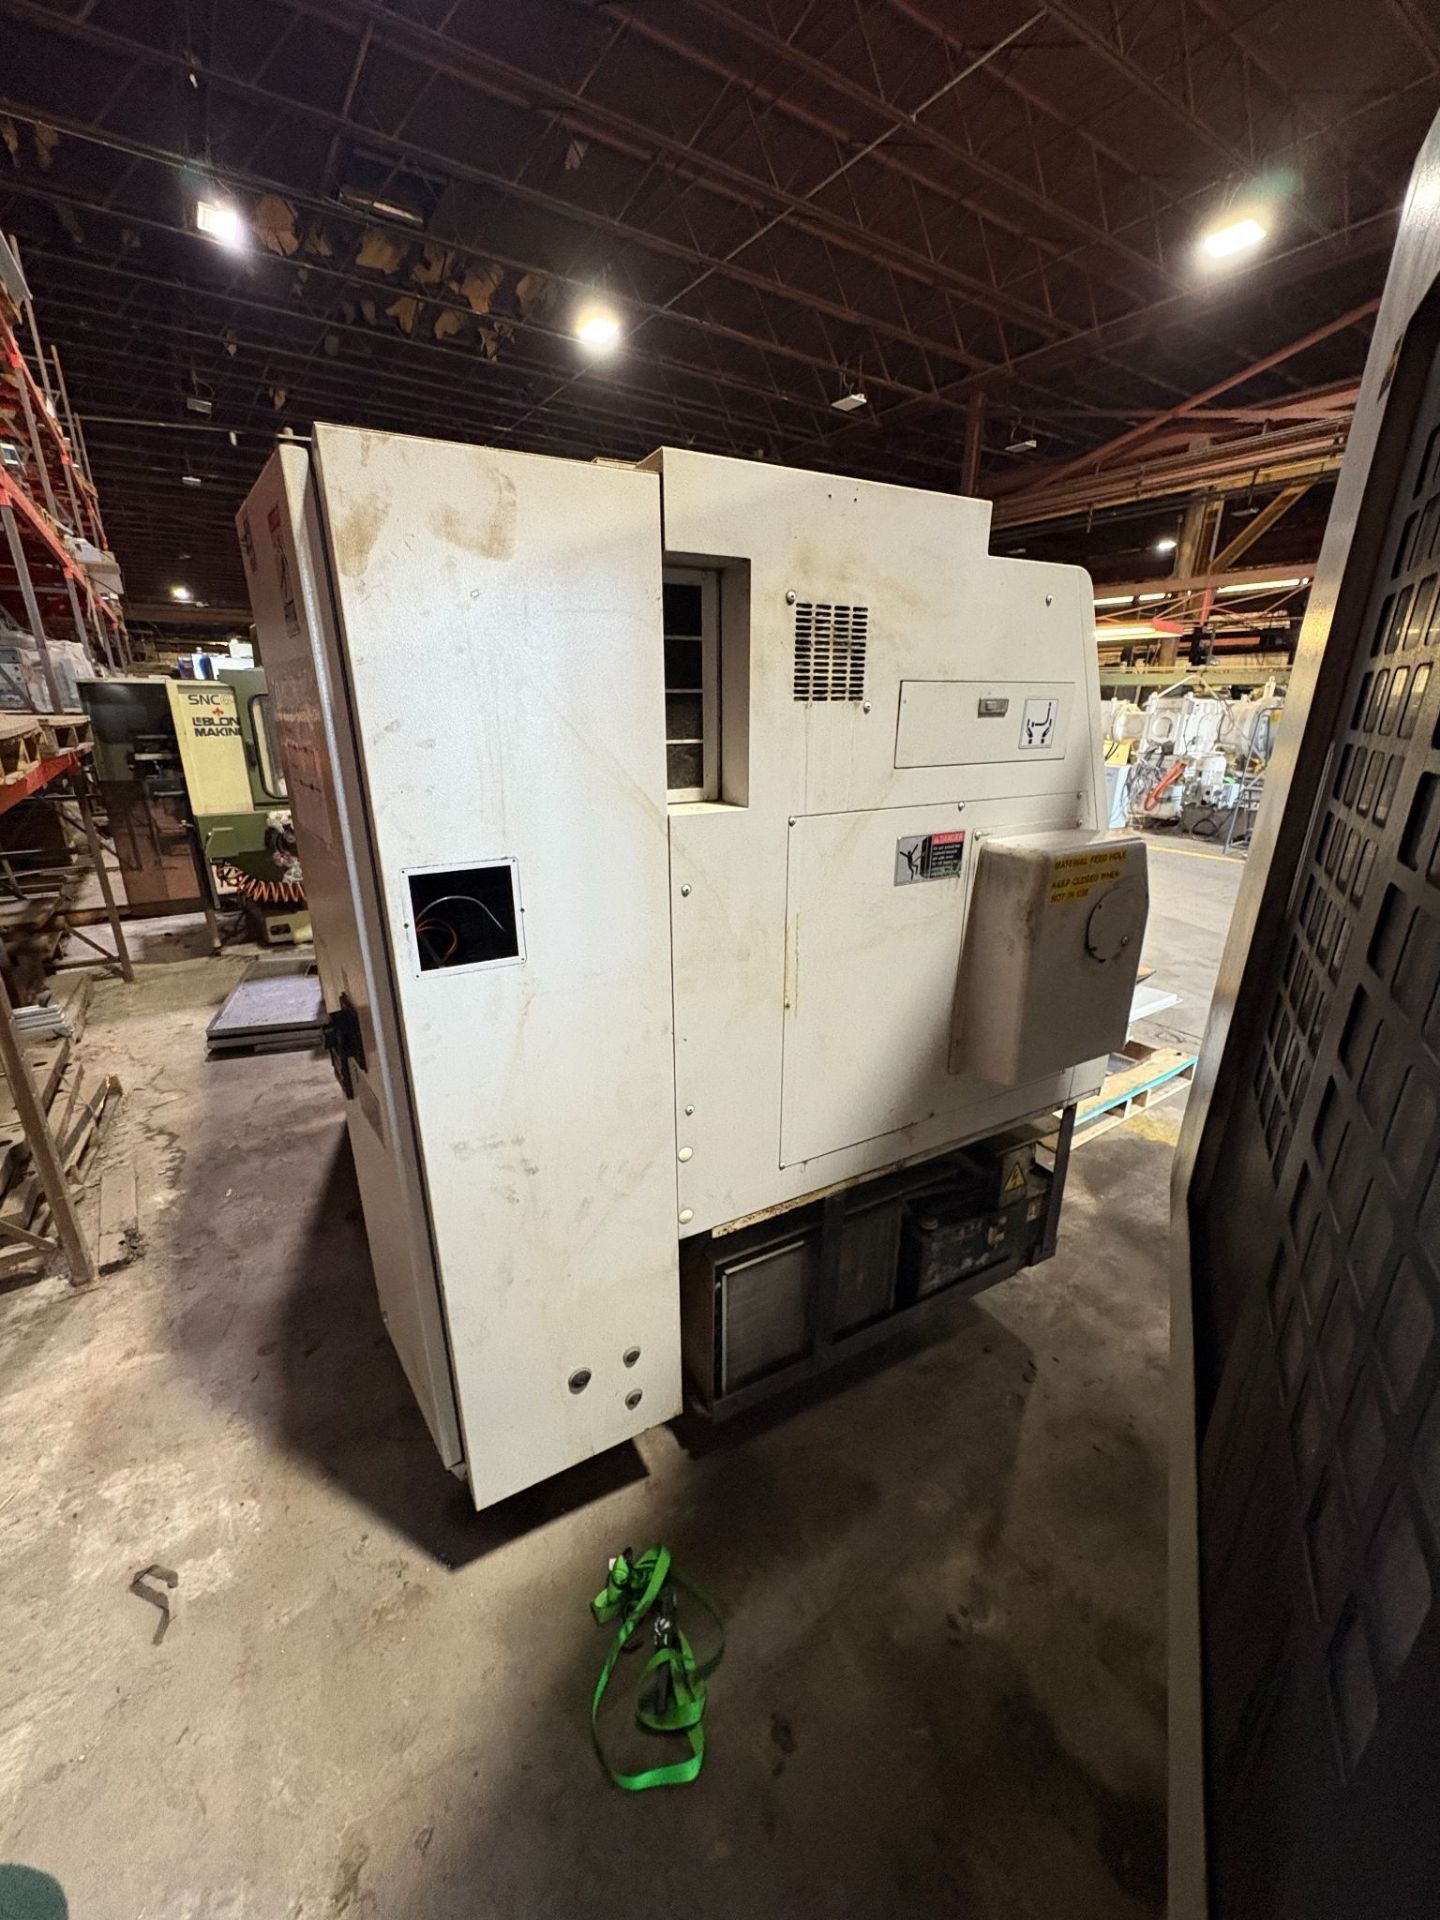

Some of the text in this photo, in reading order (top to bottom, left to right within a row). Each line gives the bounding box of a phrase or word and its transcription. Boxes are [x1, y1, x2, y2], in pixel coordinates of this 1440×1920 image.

[188, 694, 220, 705] SNC
[1090, 854, 1108, 864] FEED
[1109, 850, 1126, 861] HOLE
[1052, 871, 1120, 888] KEEP CLOSED WHEN
[1051, 893, 1065, 903] NOT
